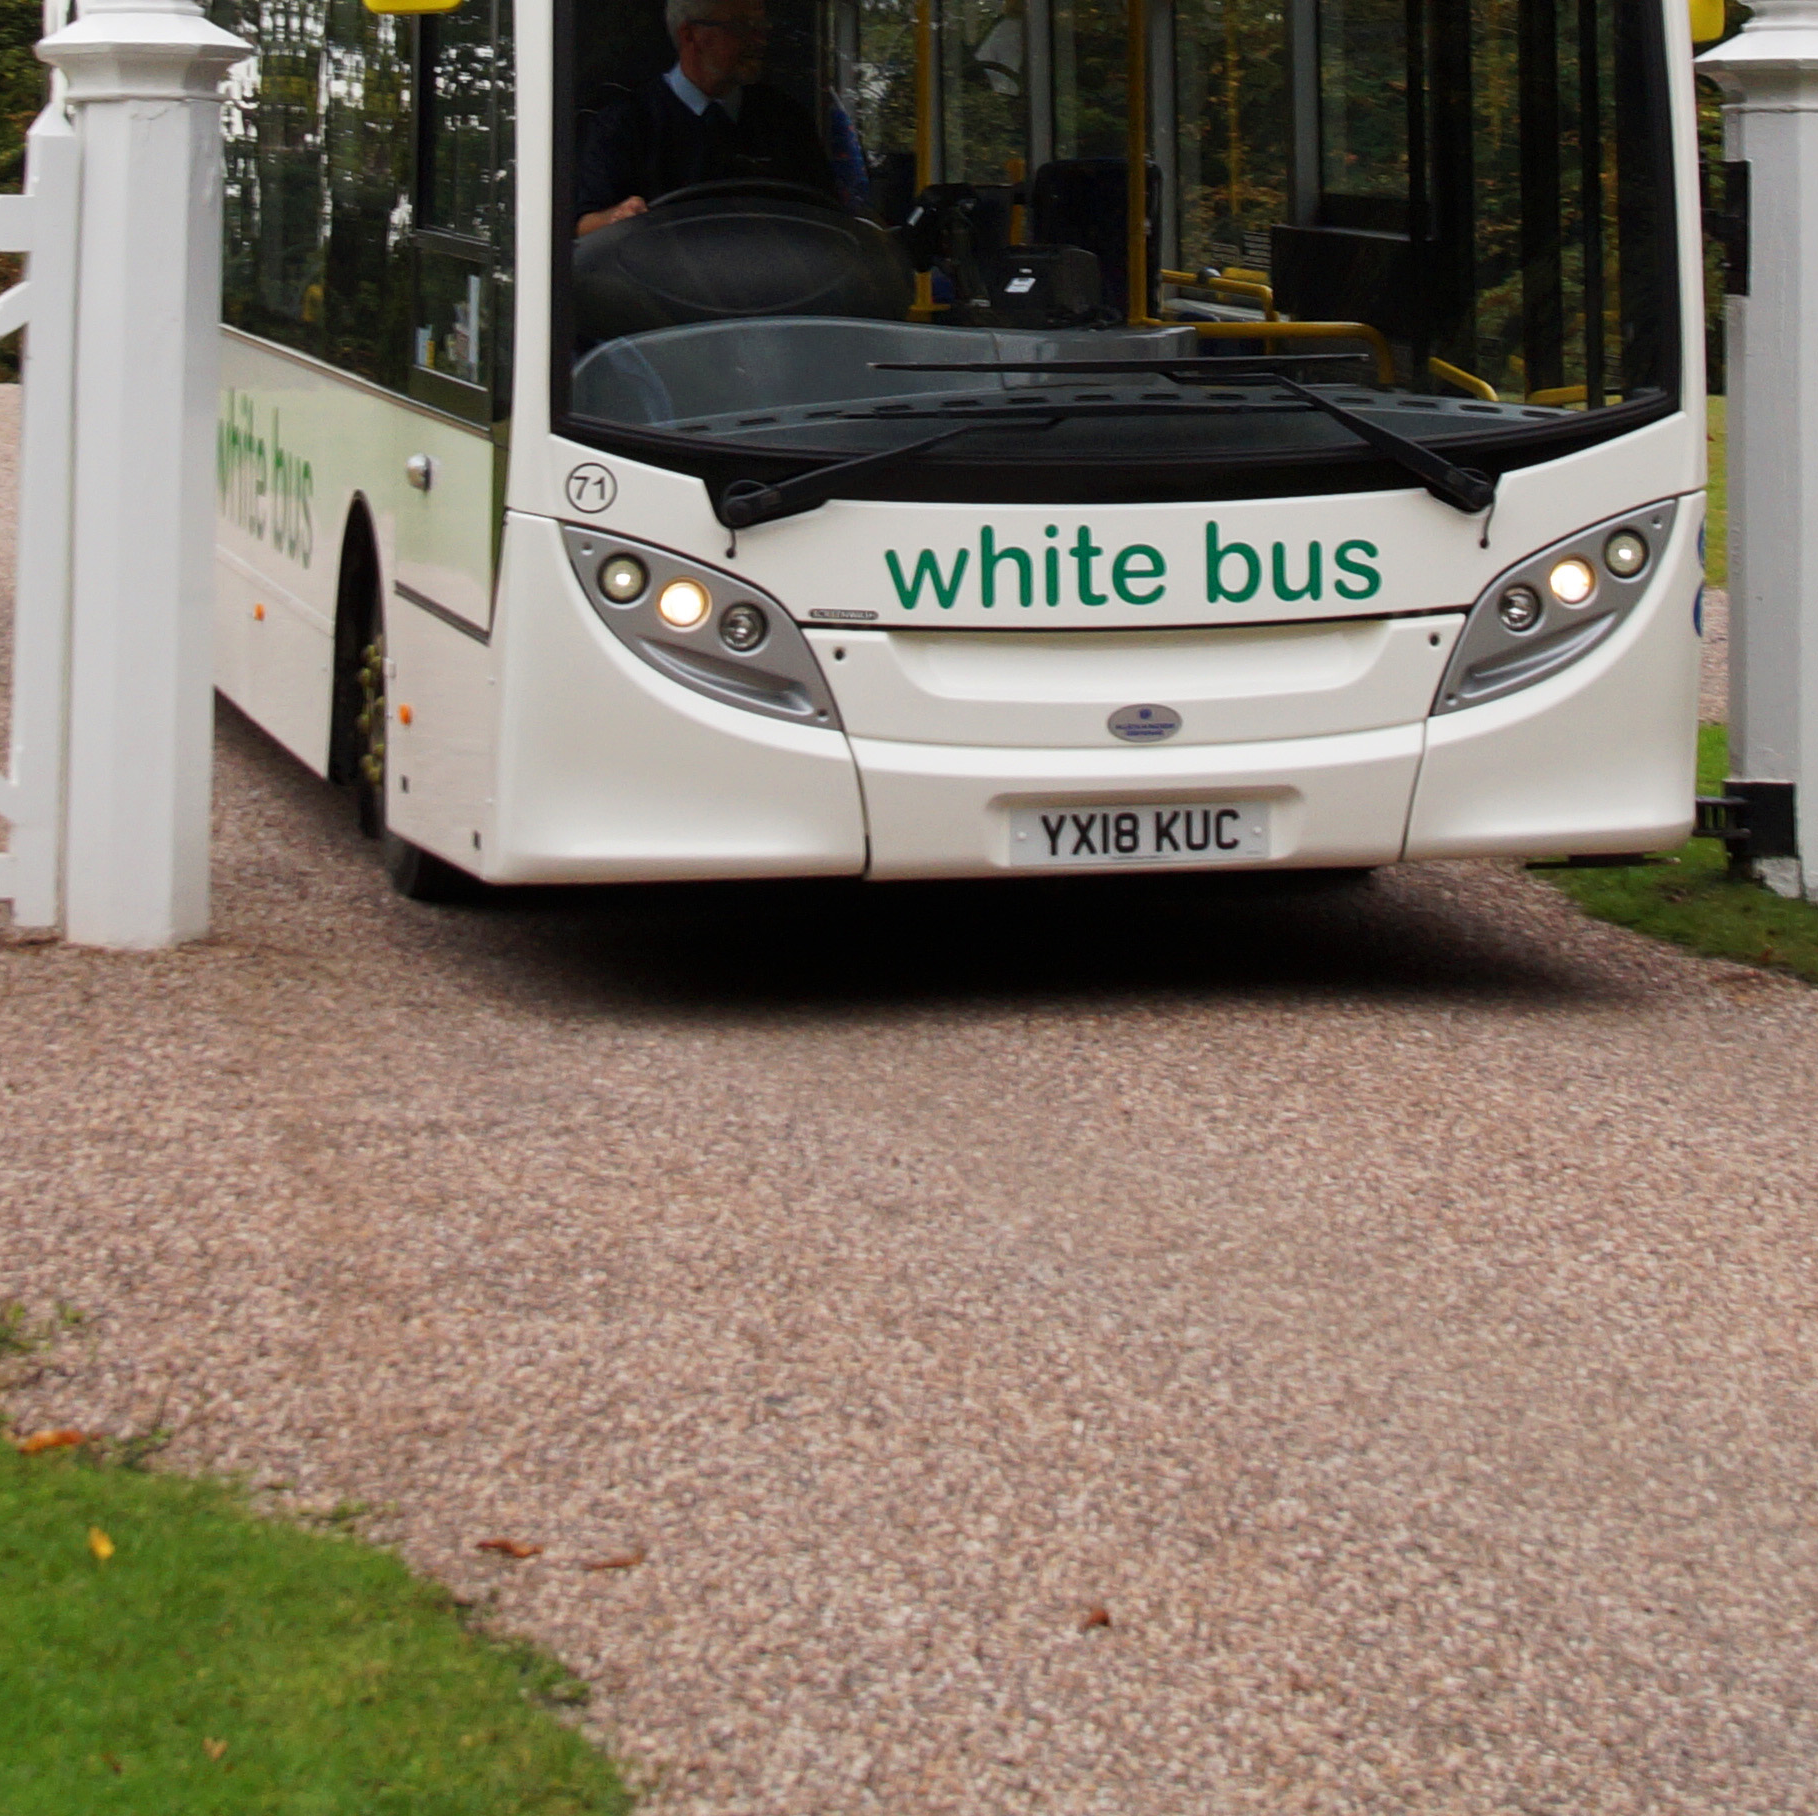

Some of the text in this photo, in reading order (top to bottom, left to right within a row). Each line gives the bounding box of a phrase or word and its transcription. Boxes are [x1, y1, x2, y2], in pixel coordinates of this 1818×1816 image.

[272, 407, 314, 570] bus
[572, 475, 606, 501] 71
[885, 520, 1382, 610] white bus
[1041, 808, 1241, 856] YX18 KUC
